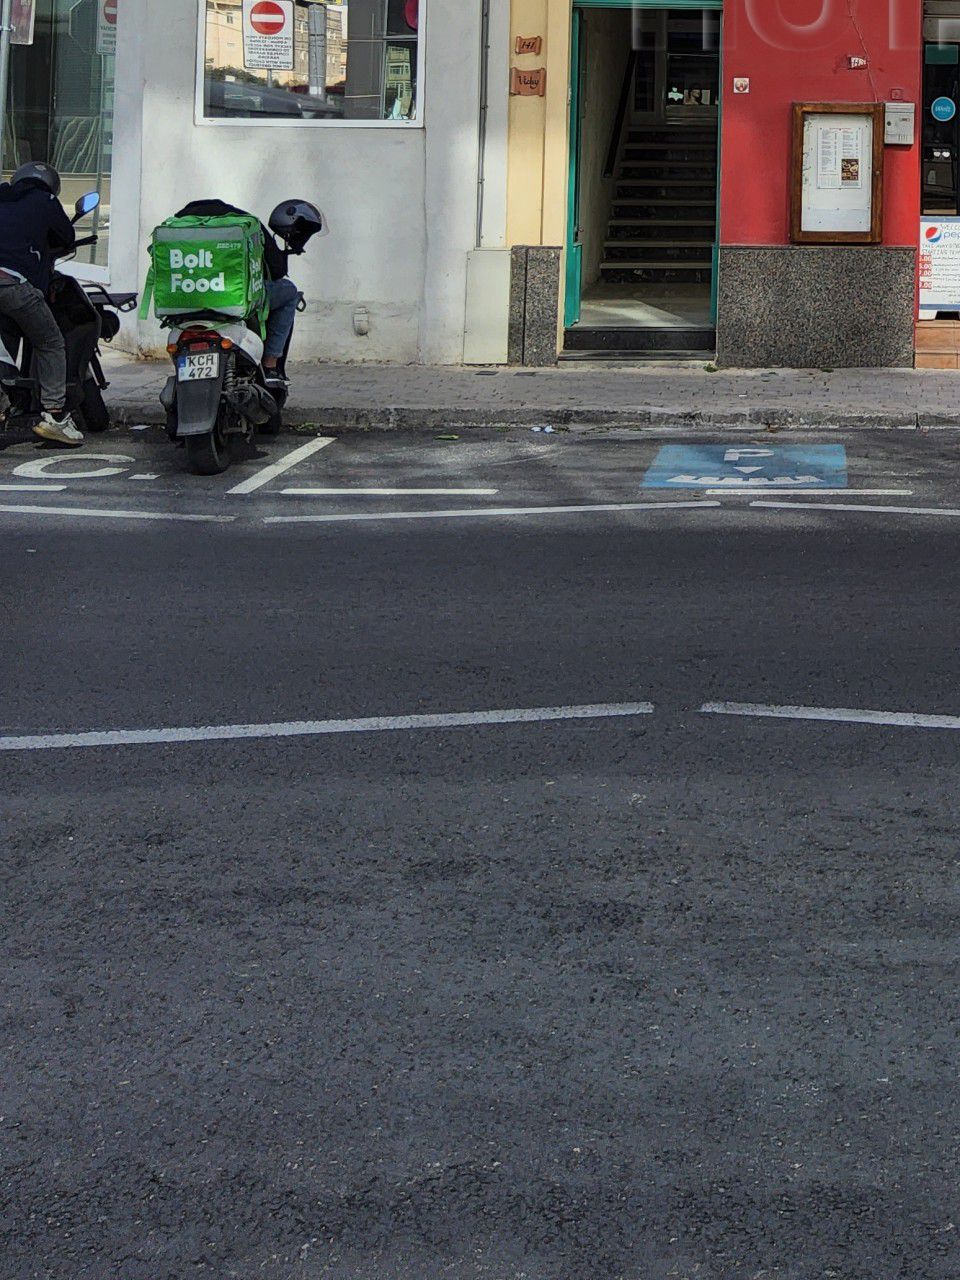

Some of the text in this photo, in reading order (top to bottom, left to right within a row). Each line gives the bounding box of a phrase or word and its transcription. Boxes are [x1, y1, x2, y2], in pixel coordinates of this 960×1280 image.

[169, 248, 213, 269] Bolt
[170, 272, 225, 293] Food
[189, 367, 212, 378] 472
